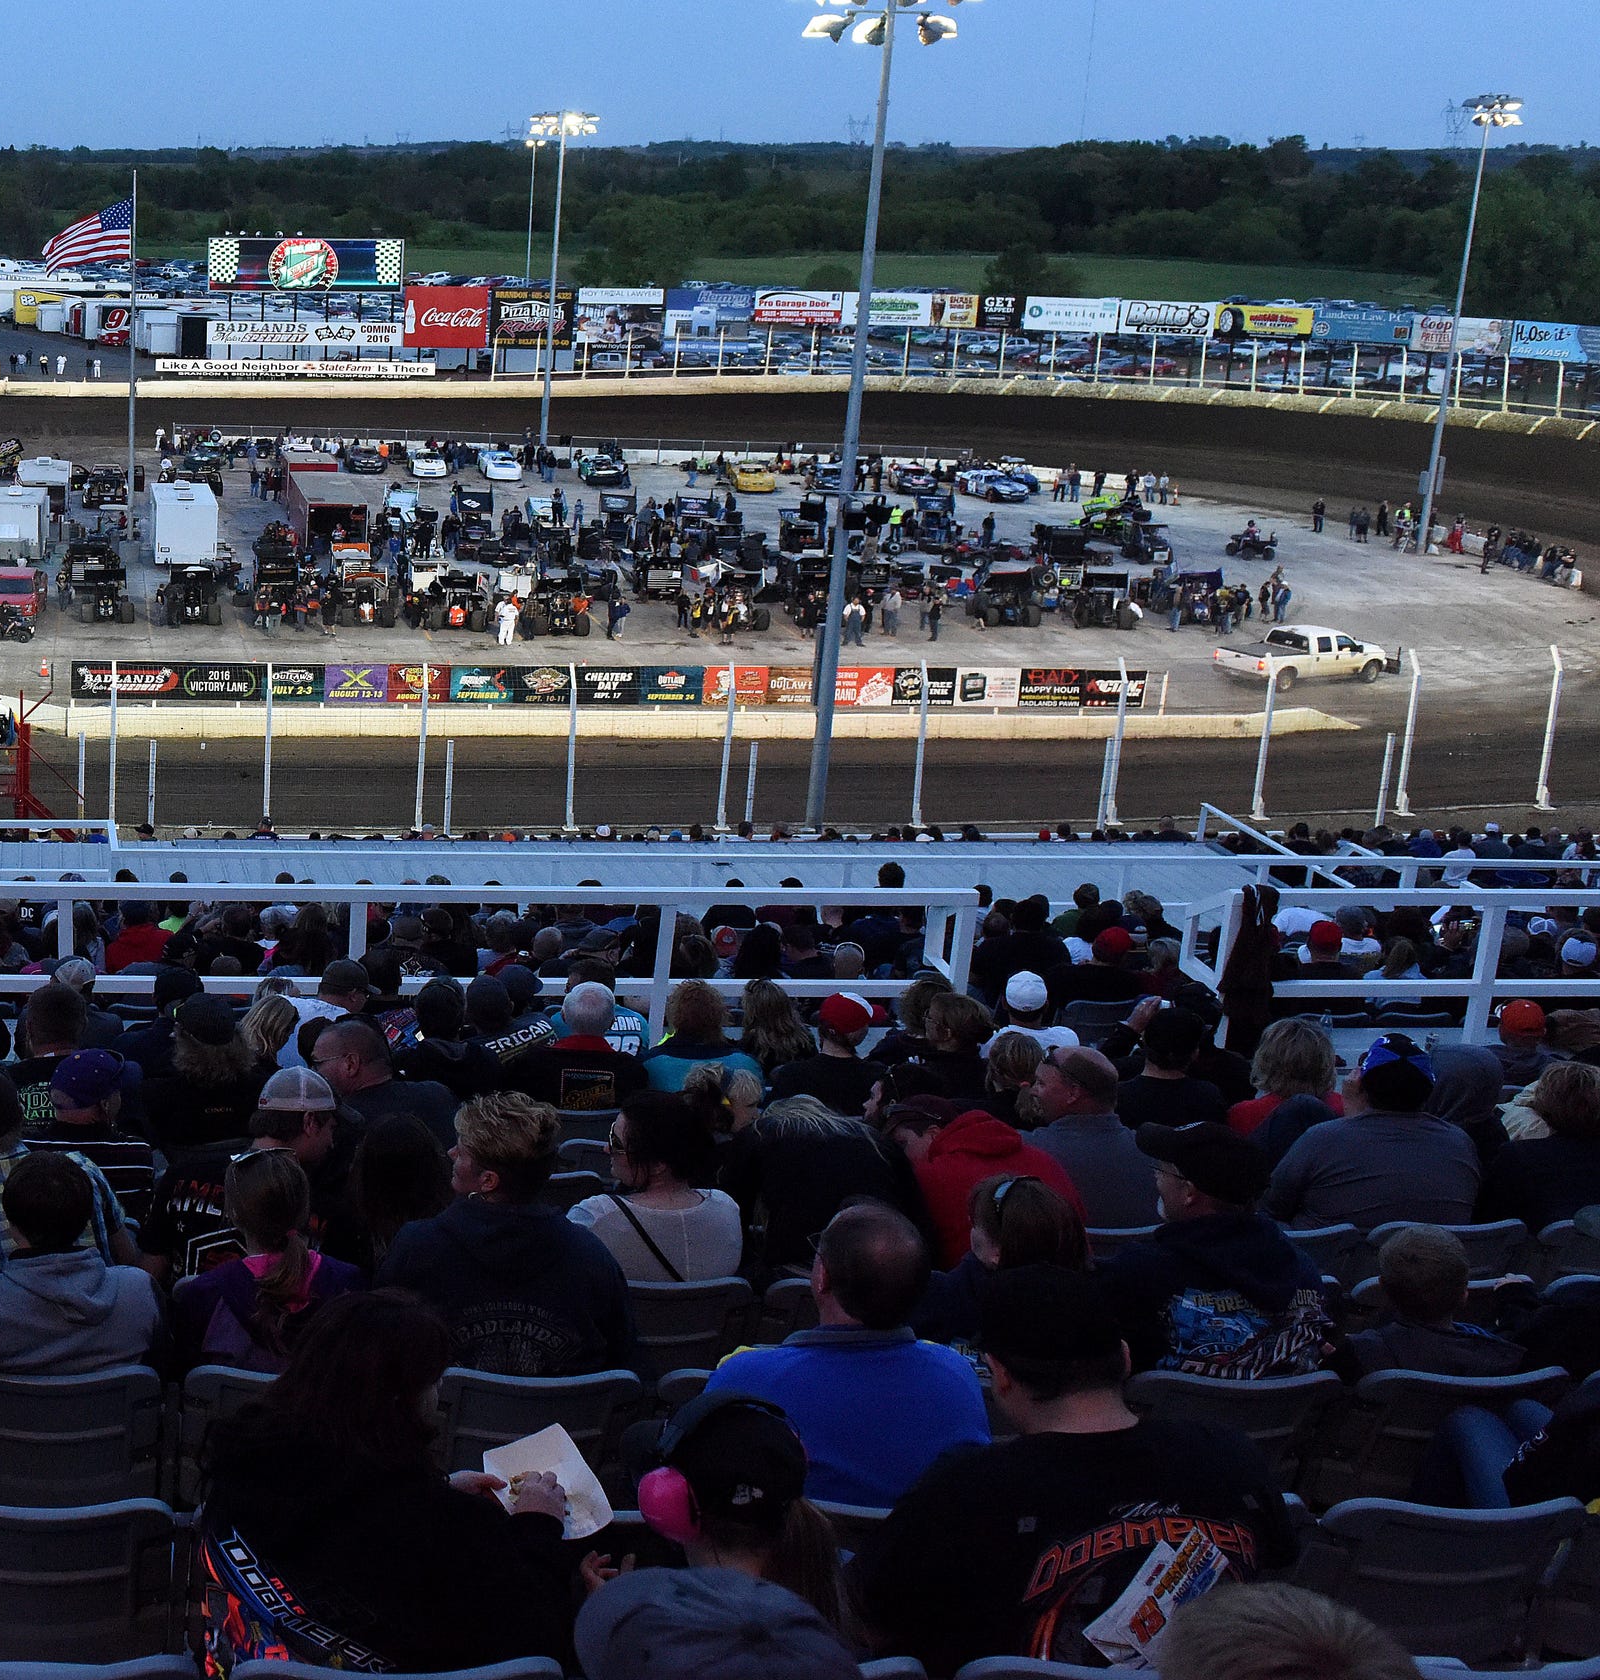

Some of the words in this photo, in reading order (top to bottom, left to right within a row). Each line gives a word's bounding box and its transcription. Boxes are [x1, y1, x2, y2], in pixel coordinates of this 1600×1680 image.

[495, 291, 528, 299] BRANDON
[776, 300, 807, 308] Garage
[985, 297, 1015, 307] GET
[501, 304, 531, 319] Pizza
[1125, 302, 1209, 328] Bolte's
[105, 309, 128, 330] 9
[215, 323, 307, 333] BADLANDS
[360, 324, 397, 334] COMING
[241, 333, 309, 343] SPEEDWAY
[366, 334, 390, 343] 2016
[1511, 345, 1531, 354] CAR
[1536, 348, 1569, 358] WASH
[162, 362, 182, 370] Like
[190, 362, 199, 370] A
[203, 362, 238, 370] Good
[242, 361, 299, 372] Neighbor
[377, 365, 389, 373] Is
[392, 365, 429, 373] There
[83, 674, 165, 684] BADLANDS
[209, 671, 230, 680] 2016
[272, 672, 314, 682] OUTLAWS
[585, 673, 633, 682] CHEATERS
[658, 675, 685, 685] OUTLAW
[1028, 669, 1079, 685] BAD
[190, 681, 224, 692] VICTORY
[227, 682, 248, 692] LANE
[597, 681, 619, 691] DAY
[771, 676, 805, 690] OUTLAW
[271, 685, 293, 695] JULY
[297, 685, 312, 695] 2-3
[329, 690, 360, 698] AUGUST
[362, 690, 383, 698] 12-13
[1054, 686, 1079, 694] HOUR
[457, 691, 499, 700] SEPTEMBER
[21, 907, 35, 919] DC
[485, 1019, 553, 1053] ERICAN
